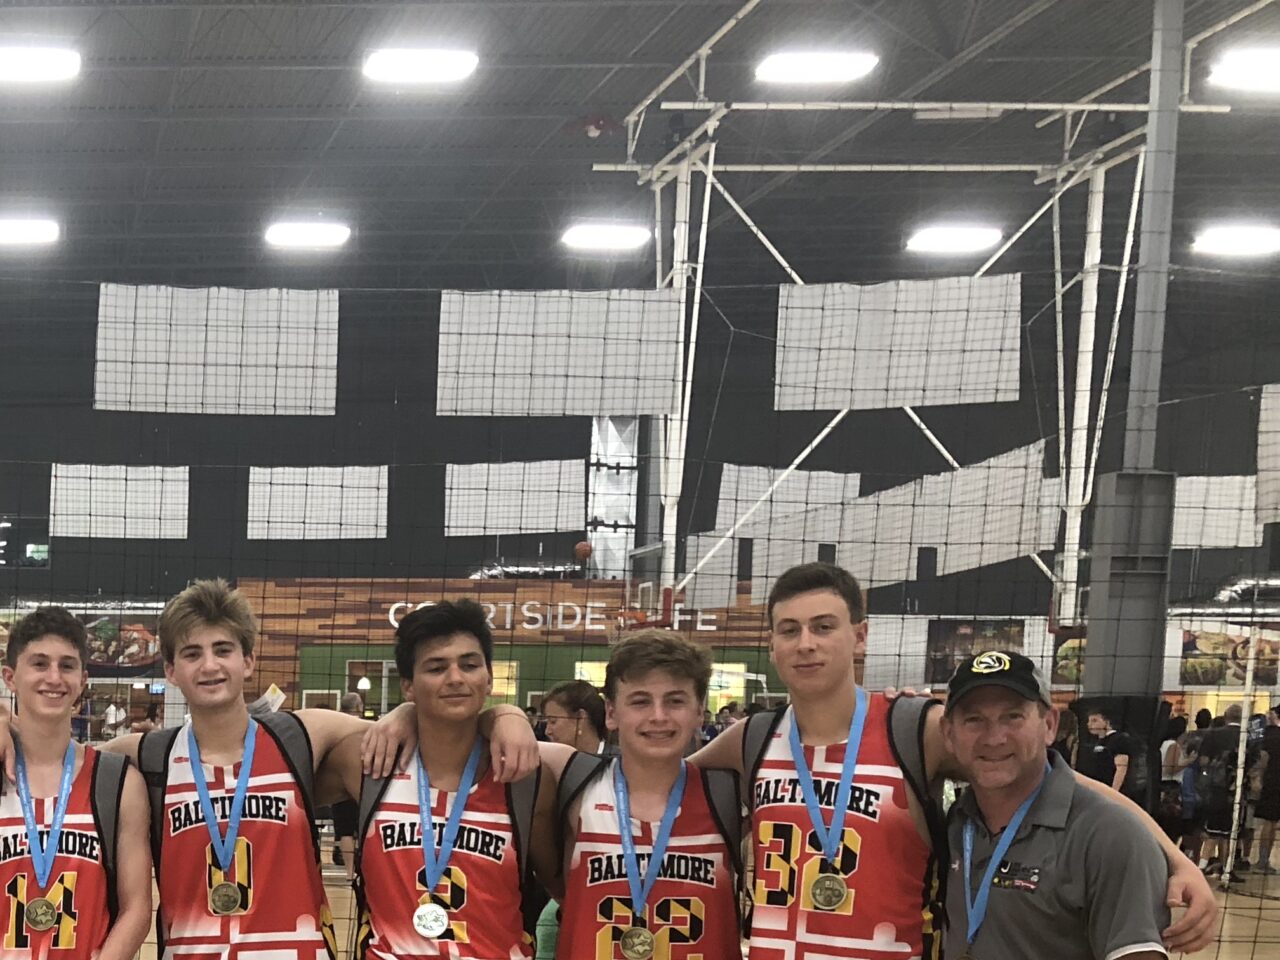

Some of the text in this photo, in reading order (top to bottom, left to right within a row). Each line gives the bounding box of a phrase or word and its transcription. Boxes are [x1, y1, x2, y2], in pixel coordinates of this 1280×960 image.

[389, 601, 606, 630] CRTSIDE
[381, 821, 506, 862] BALIMORE
[754, 821, 862, 916] 32
[3, 871, 78, 949] 14
